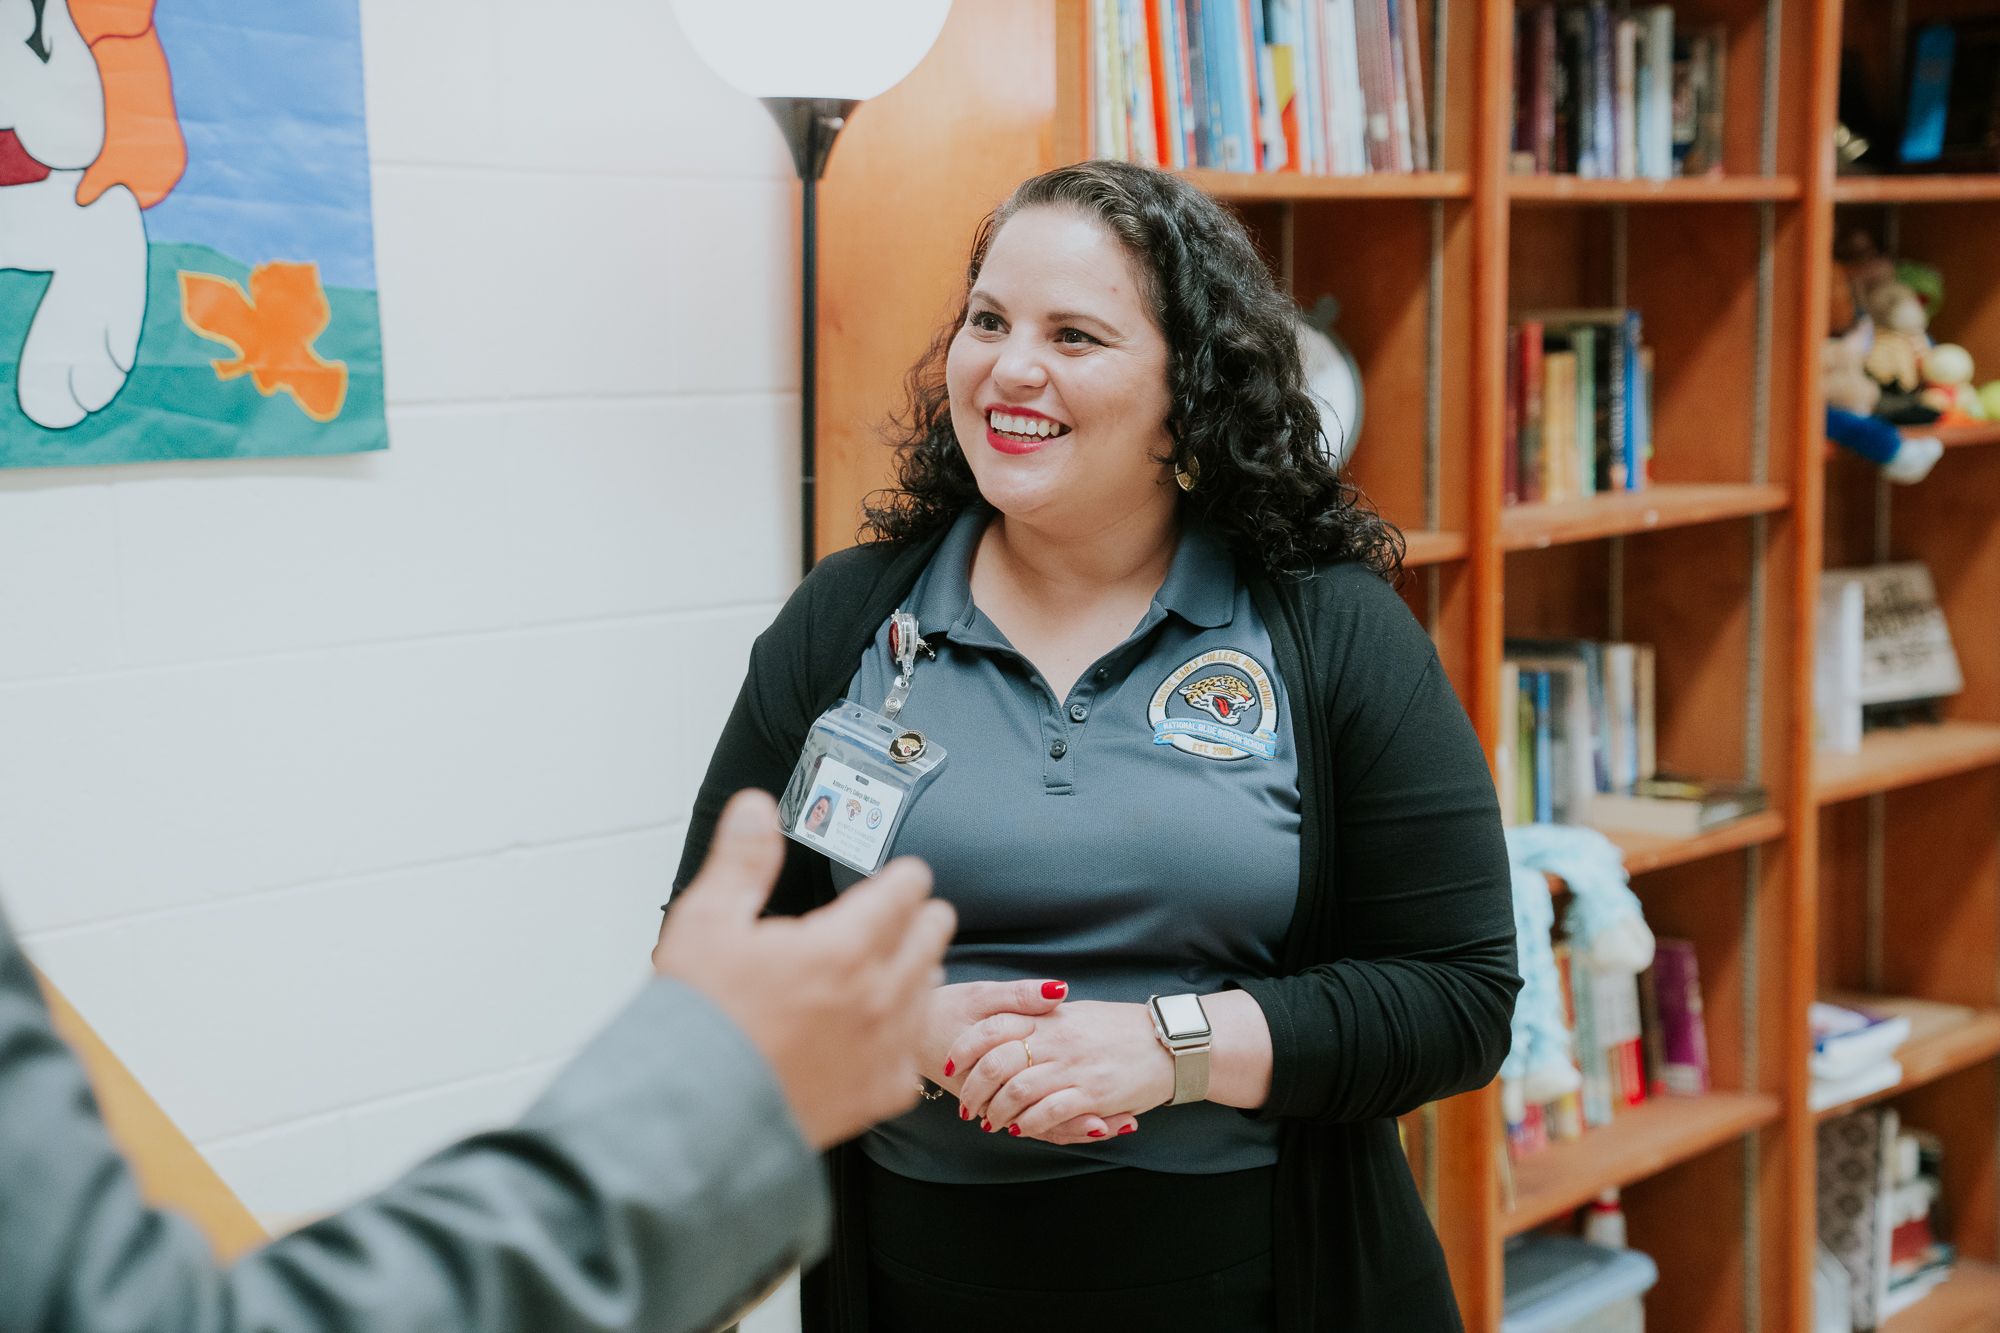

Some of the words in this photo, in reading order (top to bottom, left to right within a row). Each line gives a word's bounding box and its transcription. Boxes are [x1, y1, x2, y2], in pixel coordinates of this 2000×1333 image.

[1174, 659, 1200, 682] EARLY
[1202, 652, 1242, 664] COLLEGE
[1242, 659, 1264, 678] HIGH
[1258, 678, 1274, 710] SCHOOL
[1162, 722, 1198, 730] NATIONAL
[1198, 724, 1218, 734] BLUE
[1218, 729, 1244, 744] RIBBON
[1244, 737, 1268, 754] SCHOOL
